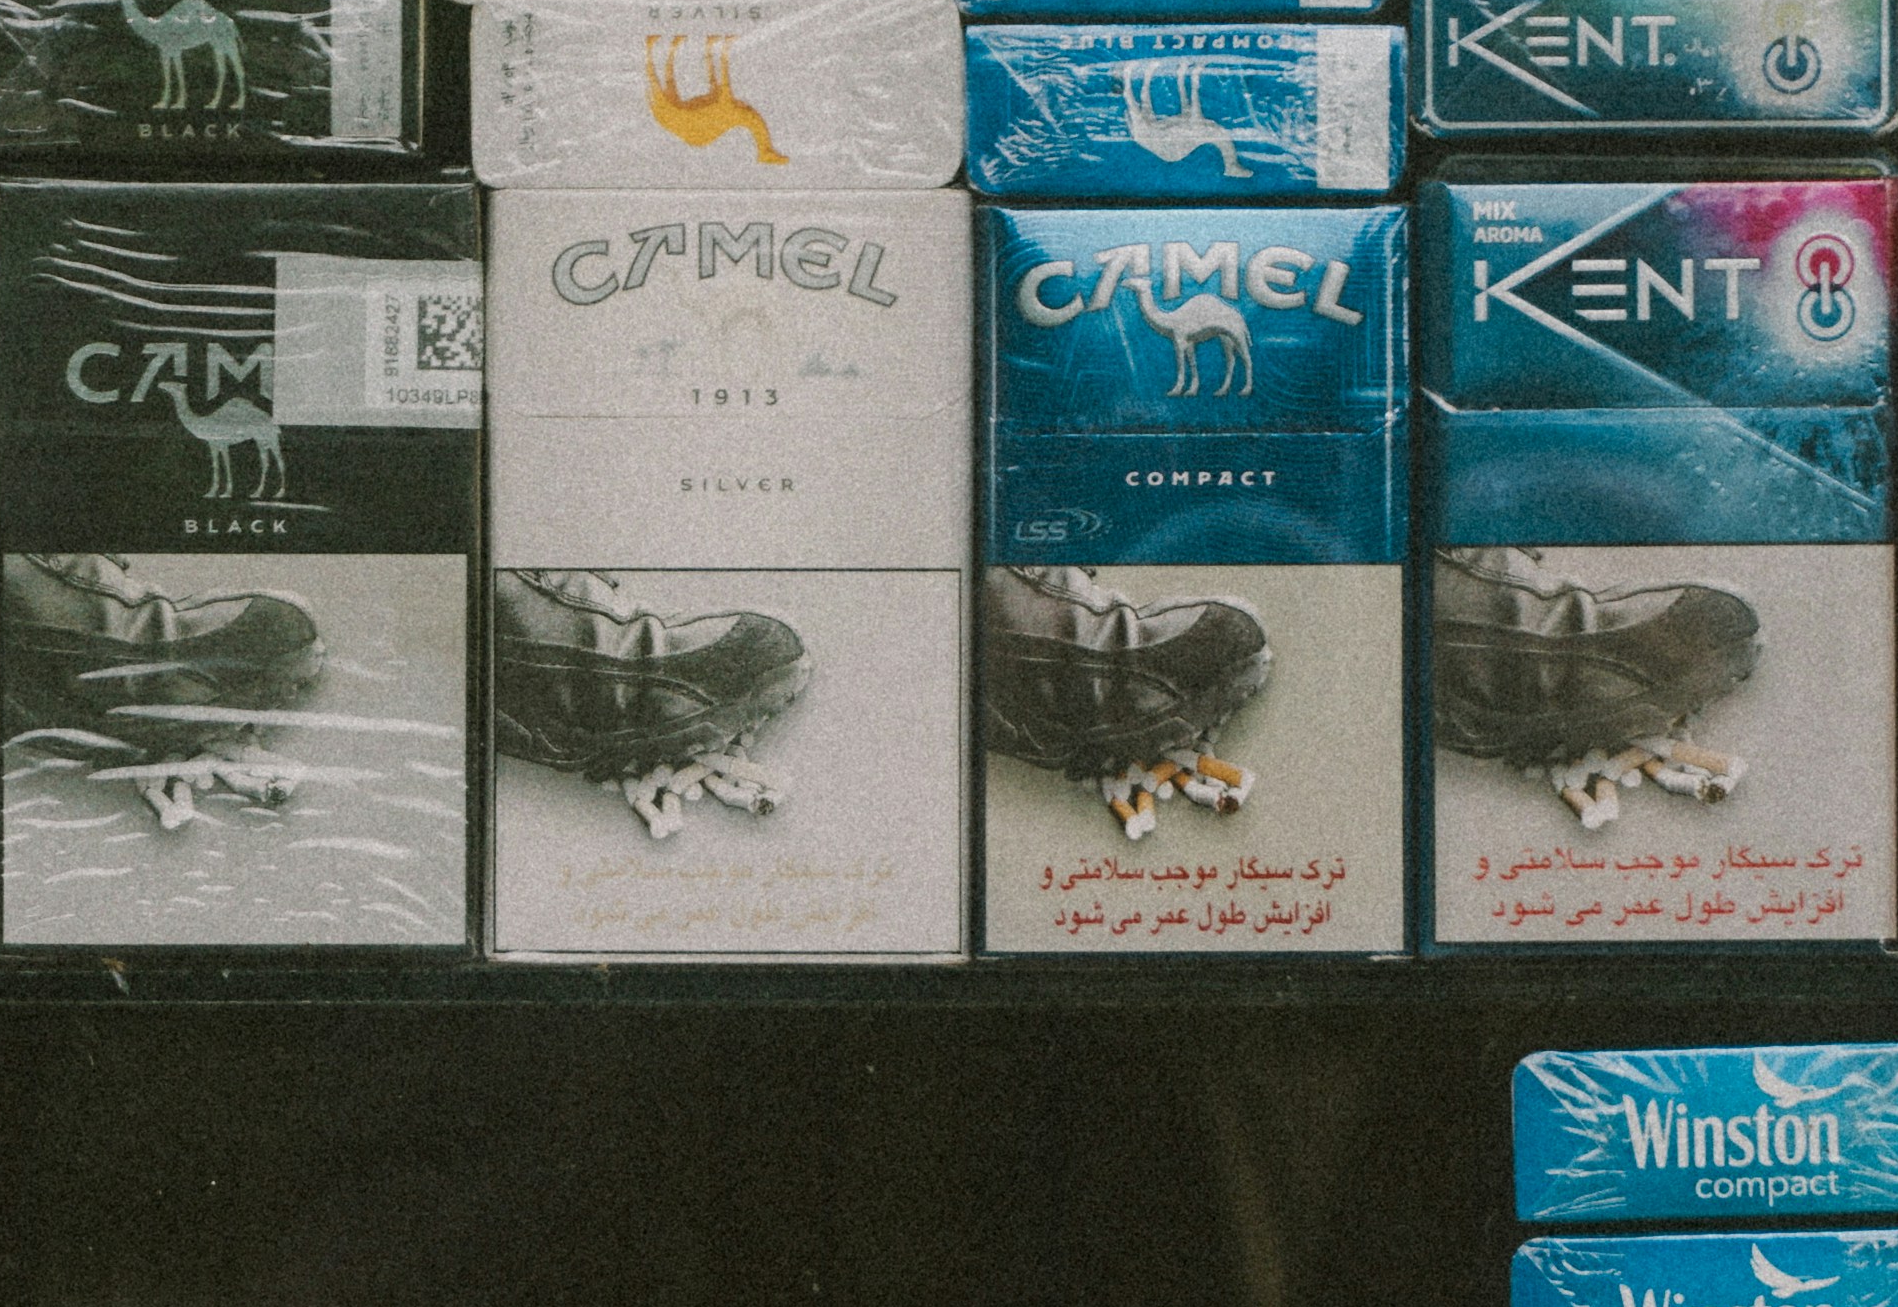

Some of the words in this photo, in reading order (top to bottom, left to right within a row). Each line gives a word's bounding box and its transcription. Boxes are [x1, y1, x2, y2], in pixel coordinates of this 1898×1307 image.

[647, 5, 761, 21] SILVER
[1058, 35, 1133, 51] BLUE
[1153, 34, 1293, 50] COMPACT
[138, 122, 242, 139] BLACK
[1473, 203, 1515, 221] MIX
[1474, 226, 1543, 244] AROMA
[553, 222, 897, 307] CAMEL
[1018, 241, 1363, 327] CAMEL
[1474, 253, 1761, 325] KENT
[692, 388, 779, 405] 1913
[681, 478, 795, 491] SILVER
[1125, 470, 1276, 486] COMPACT
[185, 519, 287, 534] BLACK
[1015, 520, 1067, 541] LSS
[1624, 1100, 1841, 1172] Winston
[1694, 1170, 1840, 1204] compact
